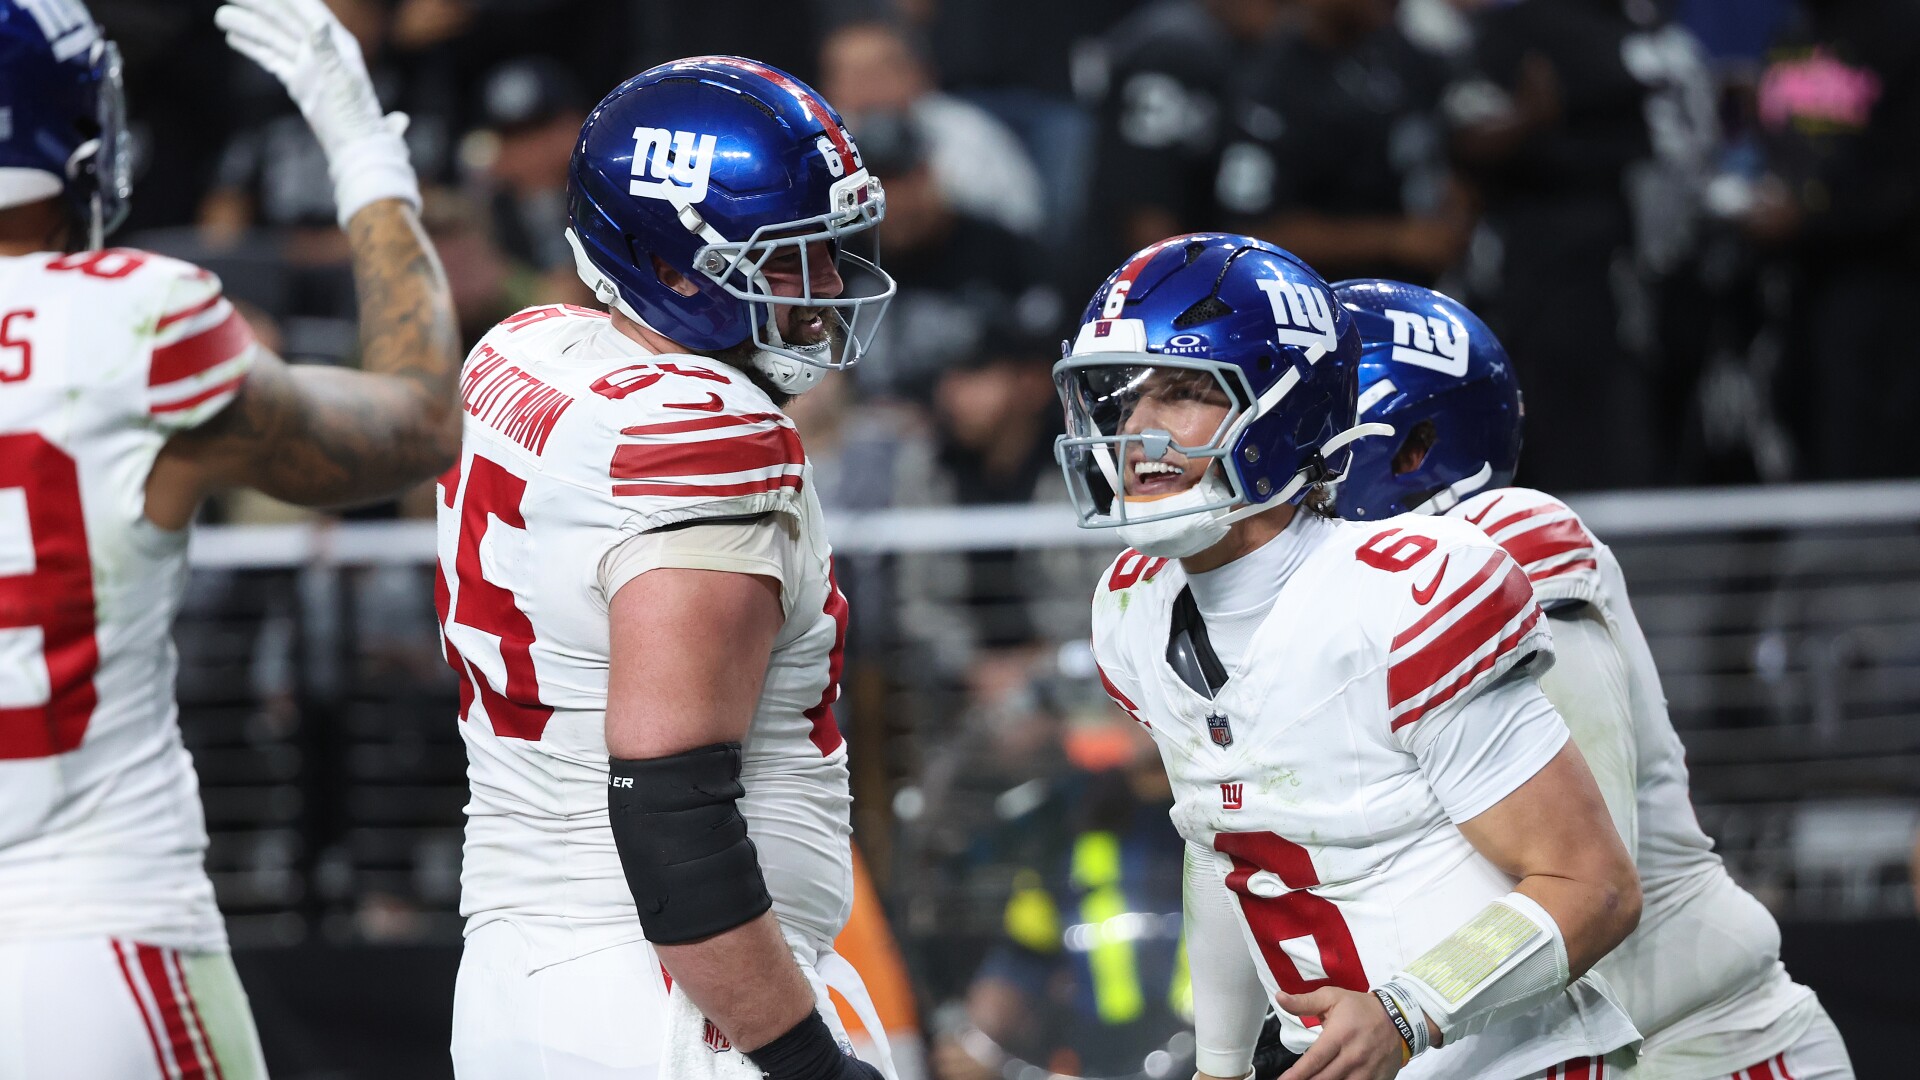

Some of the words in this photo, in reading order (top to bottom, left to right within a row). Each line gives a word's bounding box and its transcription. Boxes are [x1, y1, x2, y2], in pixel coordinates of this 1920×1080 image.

[629, 126, 717, 203] ny
[1103, 280, 1132, 319] 6
[1256, 278, 1338, 352] ny
[1163, 346, 1208, 354] OAKLEY
[1385, 308, 1469, 377] ny
[461, 343, 575, 457] CHLOTTMANN
[1355, 528, 1437, 572] 6
[1220, 783, 1243, 809] ny
[1214, 831, 1370, 1028] 6
[1376, 990, 1398, 1016] UMBLE
[1394, 1016, 1411, 1039] OVER
